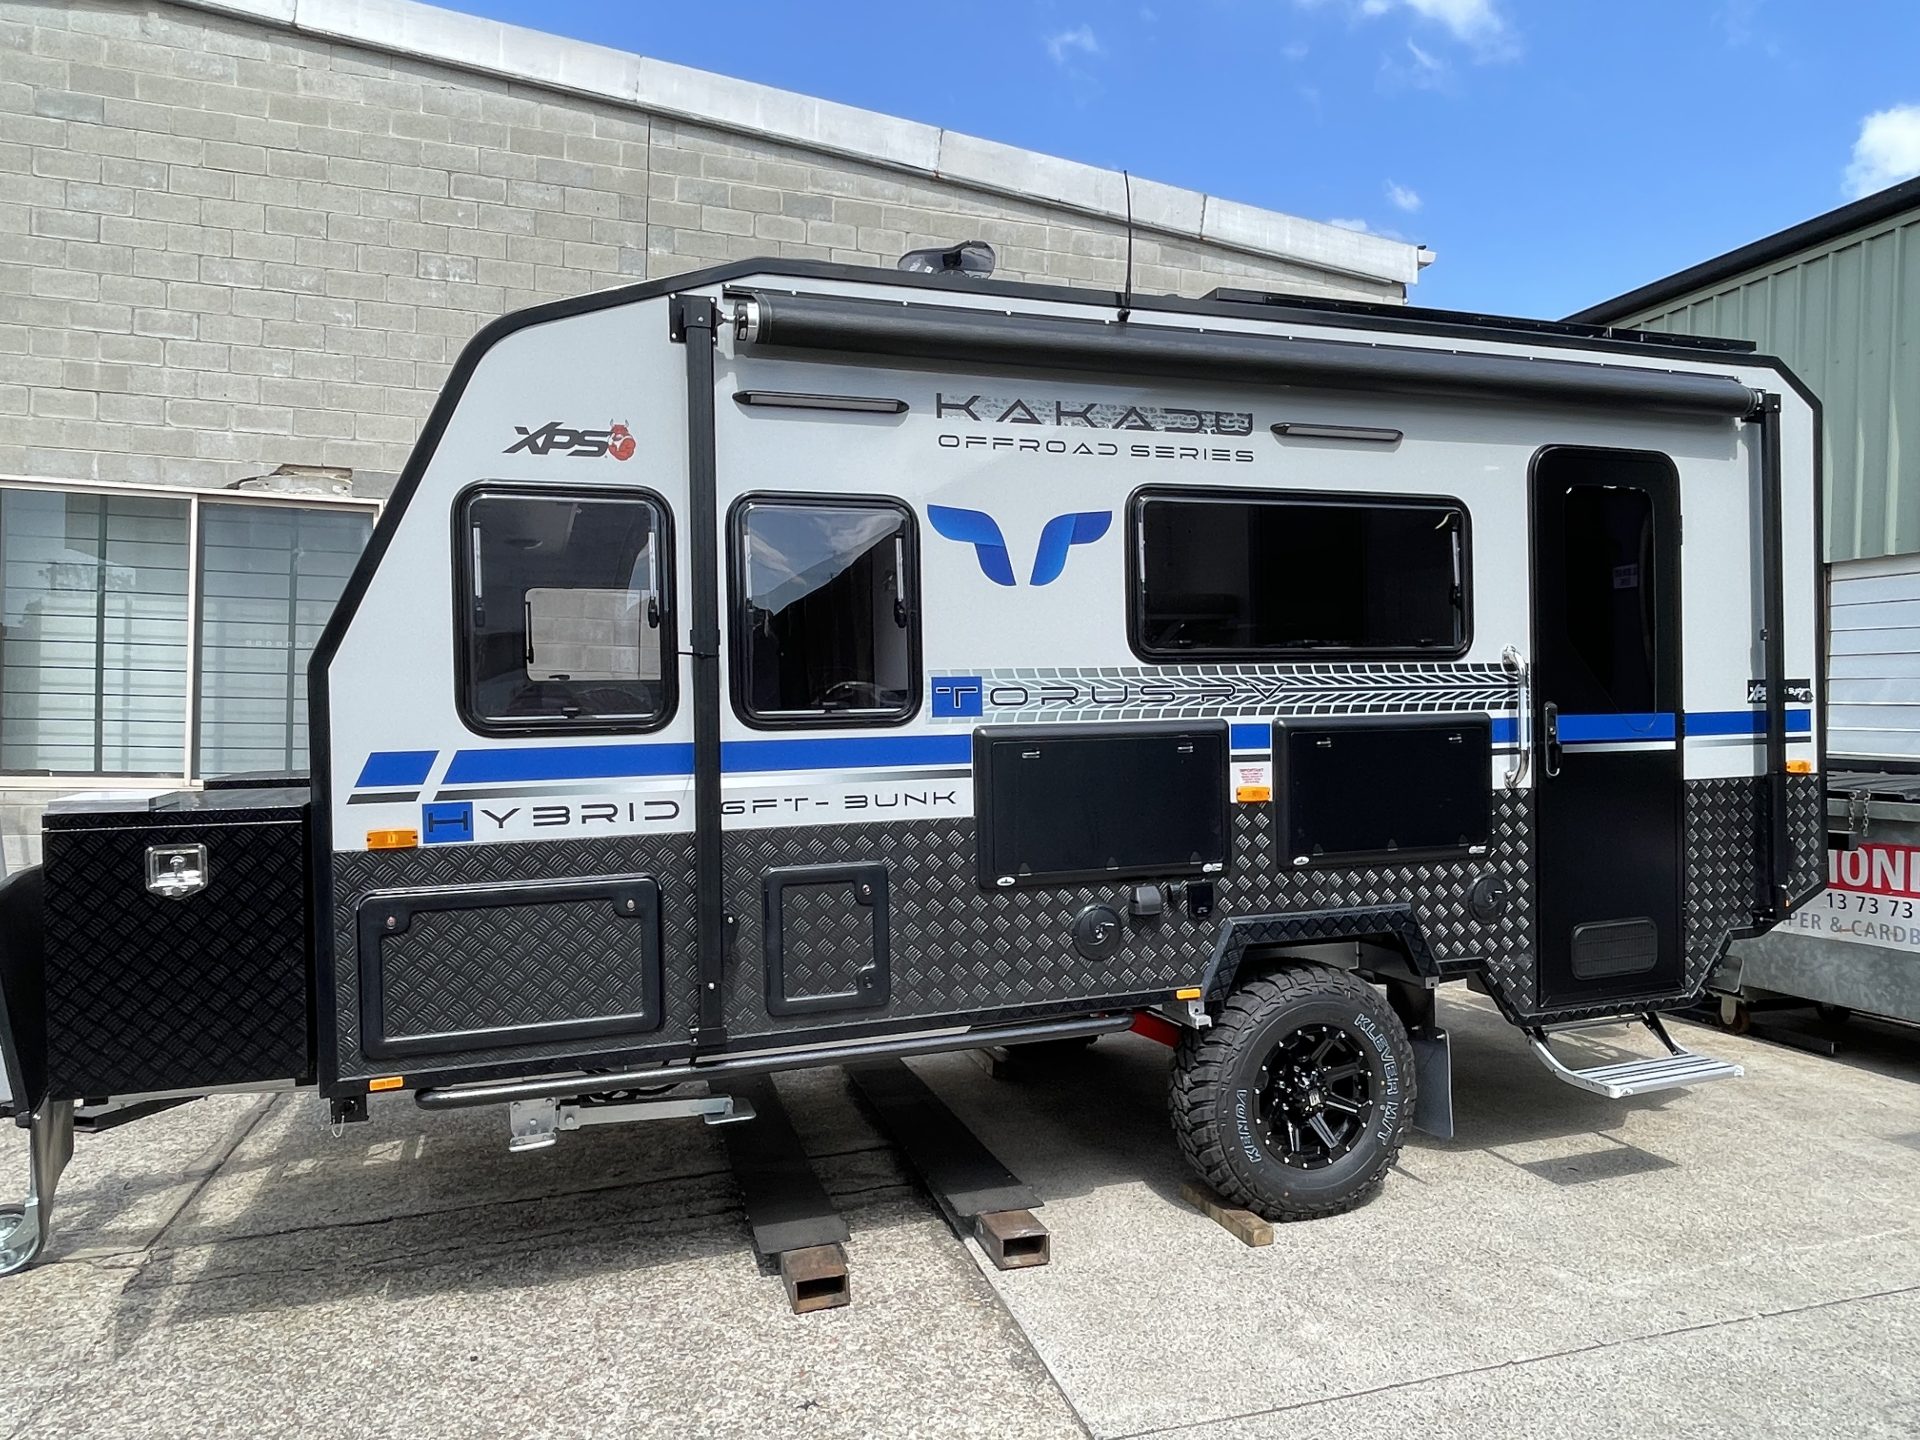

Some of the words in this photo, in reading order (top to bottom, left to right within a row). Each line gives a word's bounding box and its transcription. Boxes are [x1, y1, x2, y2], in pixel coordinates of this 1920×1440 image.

[936, 392, 1254, 437] KAKADU
[501, 421, 614, 458] XPS
[938, 434, 1118, 456] OFFROAD
[1130, 444, 1254, 463] SERIES
[935, 684, 1177, 709] TORUS
[1200, 682, 1288, 703] RV
[428, 800, 680, 833] HYBRID
[844, 790, 957, 810] BUNK
[1826, 892, 1848, 910] 13
[1856, 895, 1879, 915] 73
[1888, 899, 1913, 919] 73
[1353, 1013, 1399, 1095] KLEVER
[1235, 1089, 1262, 1163] KENDA
